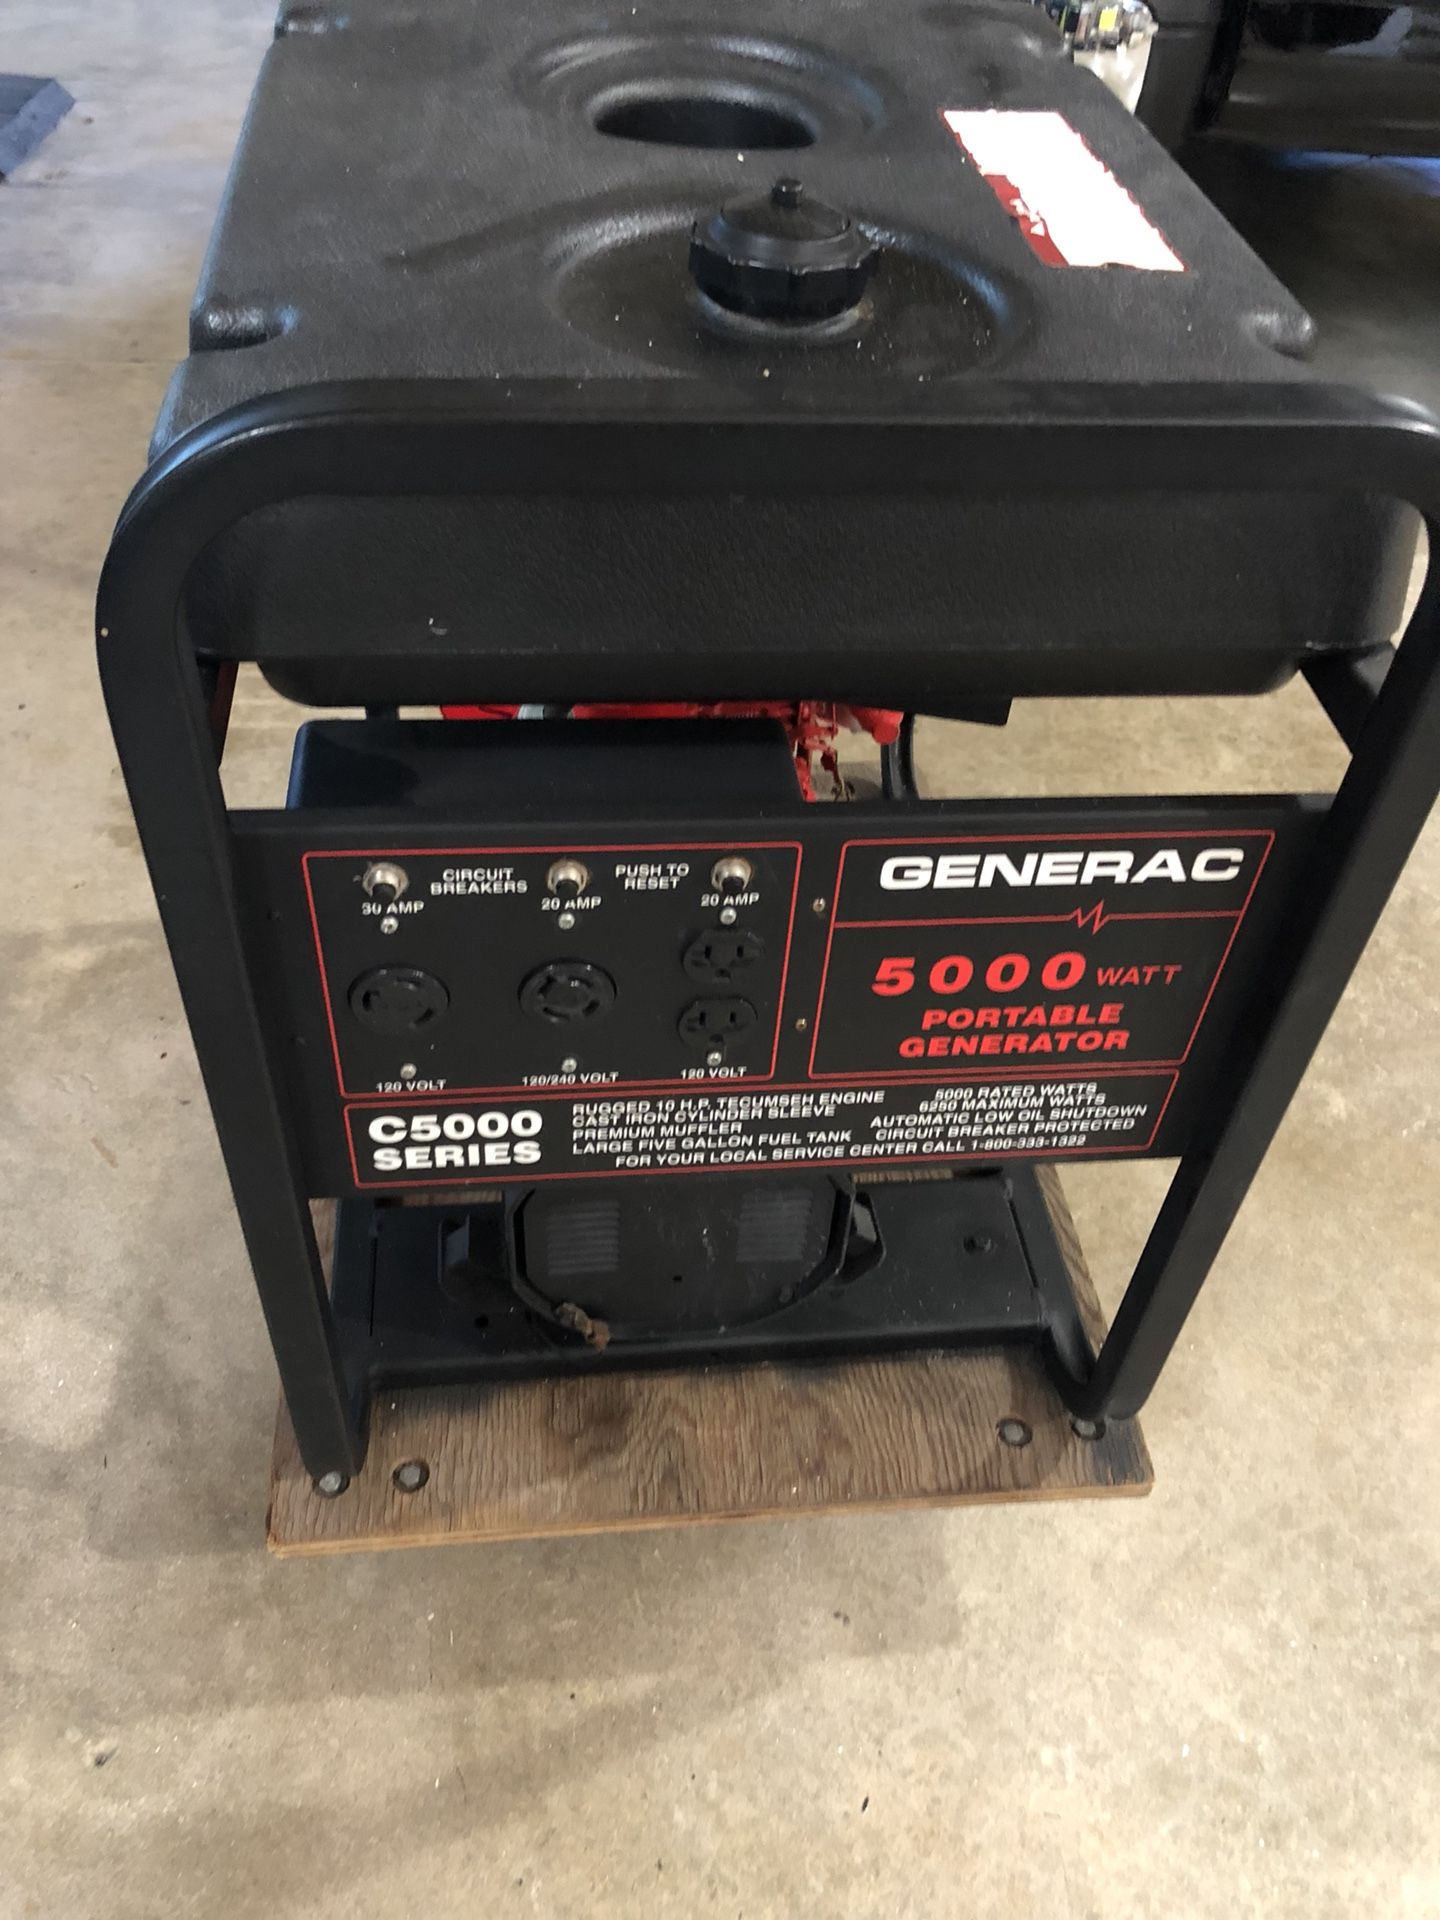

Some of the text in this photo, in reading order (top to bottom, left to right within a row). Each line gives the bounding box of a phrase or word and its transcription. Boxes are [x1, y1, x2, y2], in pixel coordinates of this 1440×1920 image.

[442, 867, 514, 882] CIRCUIT
[615, 863, 690, 878] PUSH TO
[879, 848, 1245, 891] GENERAC
[430, 880, 528, 896] BREAKERS
[624, 876, 681, 890] RESET
[362, 901, 425, 915] 30 AMP
[541, 896, 602, 911] 20 AMP
[700, 892, 760, 907] 20 AMP
[871, 951, 1182, 997] 5000 WATT
[921, 1002, 1124, 1031] PORTABLE
[899, 1029, 1130, 1058] GENERATOR
[580, 1071, 619, 1084] VOLT
[709, 1066, 747, 1079] VOLT
[376, 1079, 447, 1094] 120 VOLT
[978, 1085, 1035, 1099] RATED
[1040, 1082, 1098, 1096] WATTS
[572, 1100, 650, 1117] RUGGED
[656, 1099, 675, 1112] 10
[717, 1094, 814, 1109] TECUMSEH
[819, 1090, 885, 1106] ENGINE
[962, 1096, 1044, 1111] MAXIMUM
[1050, 1093, 1106, 1107] WATTS
[572, 1104, 836, 1128] CAST IRON CYLINDER SLEEVE
[870, 1104, 1148, 1128] AUTOMATIC LOW OIL SHUTDOWN
[368, 1109, 543, 1143] C5000
[572, 1122, 743, 1141] PREMIUM MUFFLER
[875, 1118, 1135, 1141] CIRCUIT BREAKER PROTECTED
[572, 1129, 852, 1155] LARGE FIVE GALLON FUEL TANK
[373, 1140, 542, 1171] SERIES
[615, 1154, 651, 1168] FOR
[656, 1151, 705, 1166] YOUR
[710, 1148, 768, 1163] LOCAL
[771, 1145, 844, 1161] SERVICE
[849, 1144, 916, 1157] CENTER
[922, 1139, 965, 1154] CALL
